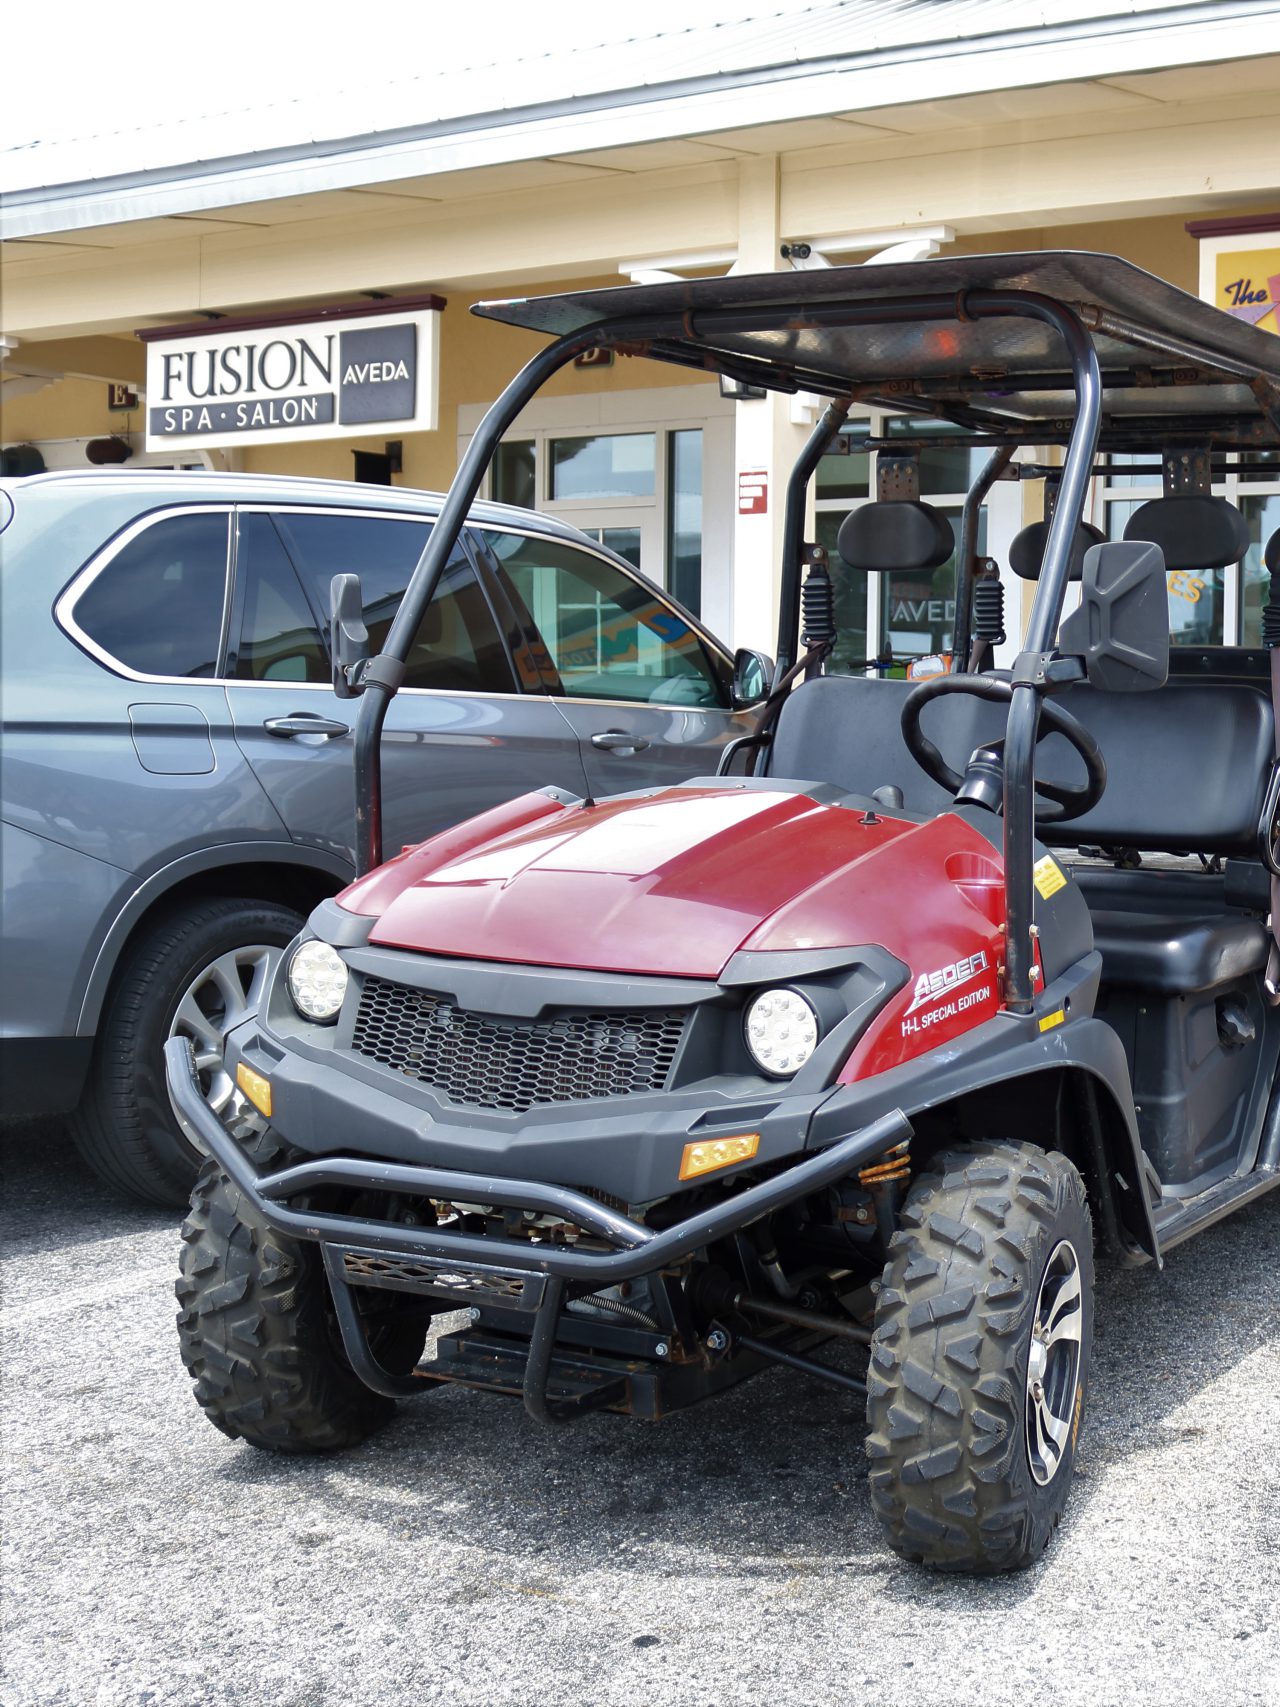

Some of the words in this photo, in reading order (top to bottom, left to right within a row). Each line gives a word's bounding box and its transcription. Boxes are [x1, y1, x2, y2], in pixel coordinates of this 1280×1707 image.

[1224, 278, 1268, 306] The
[160, 334, 336, 401] FUSION
[342, 359, 410, 386] AVEDA
[164, 407, 213, 432] SPA
[235, 397, 319, 427] SALON
[892, 600, 957, 622] AVED
[901, 1016, 921, 1037] H-L
[921, 1002, 958, 1028] SPECIAL
[958, 985, 990, 1012] EDITION
